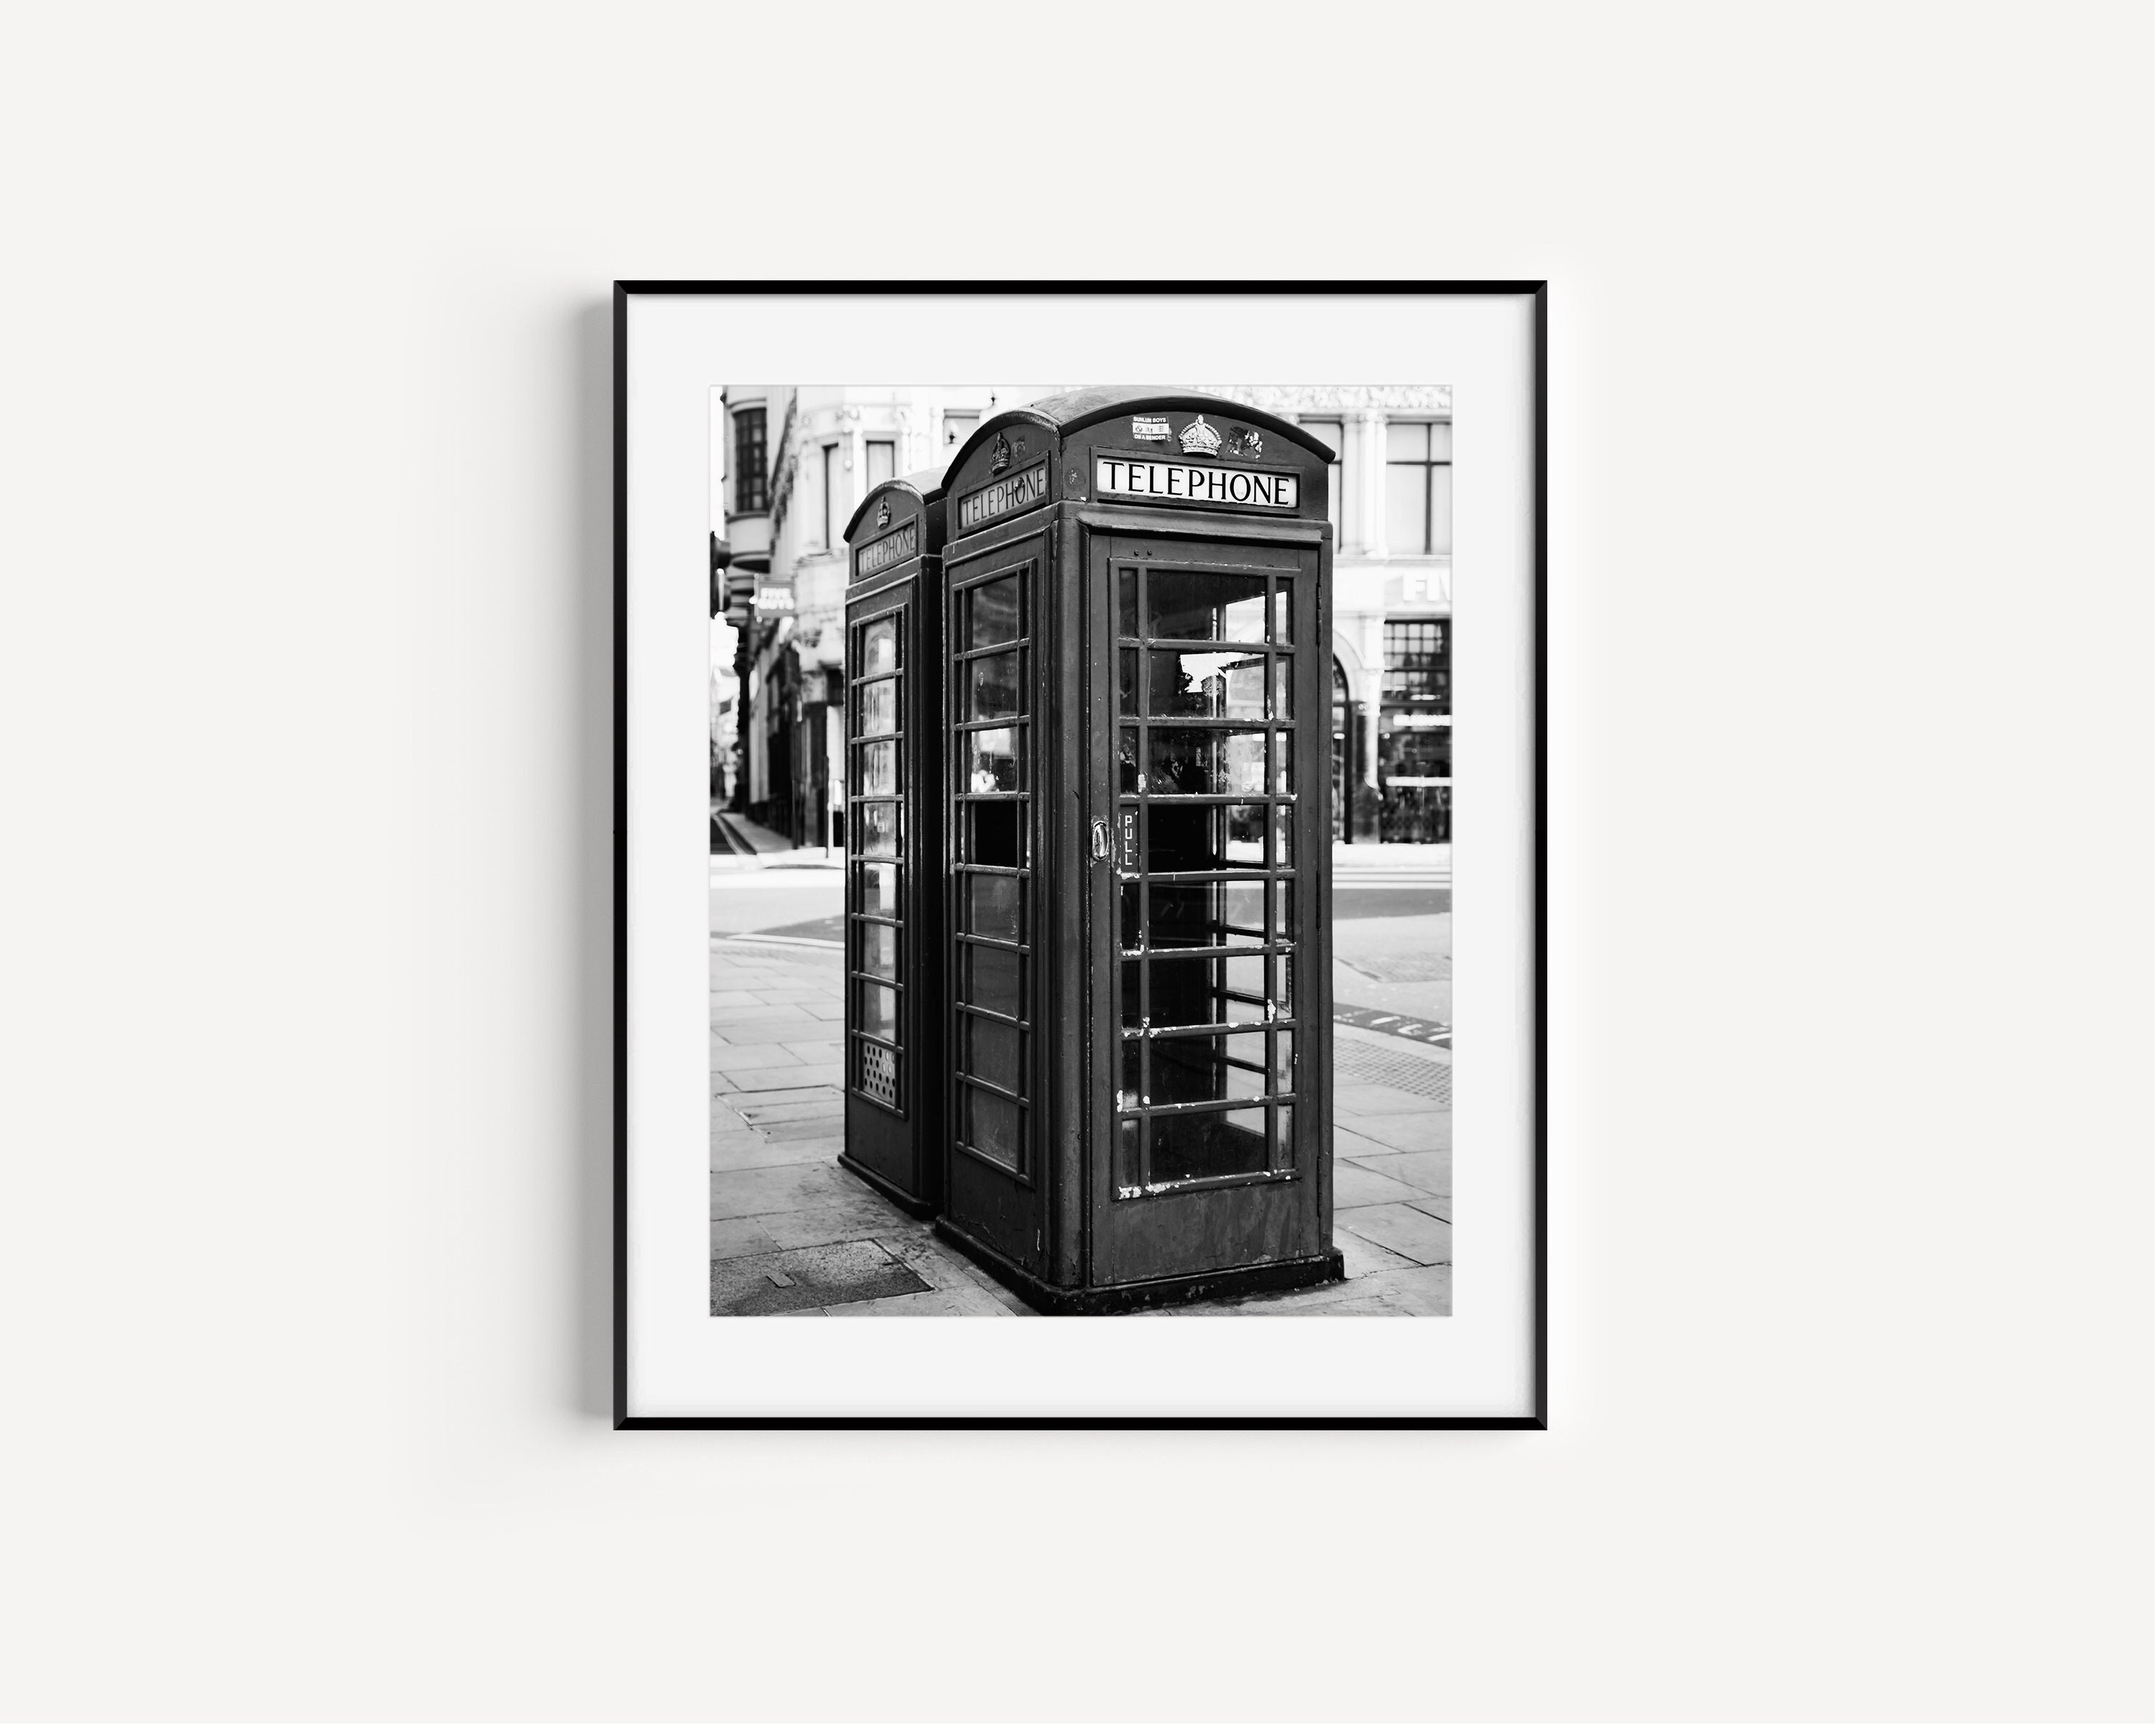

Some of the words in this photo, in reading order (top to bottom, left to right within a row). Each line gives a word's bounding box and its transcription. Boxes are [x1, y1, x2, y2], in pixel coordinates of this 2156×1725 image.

[963, 467, 1045, 525] TELEPHONE
[1102, 461, 1290, 505] TELEPHONE
[859, 528, 915, 574] TELEPHONE
